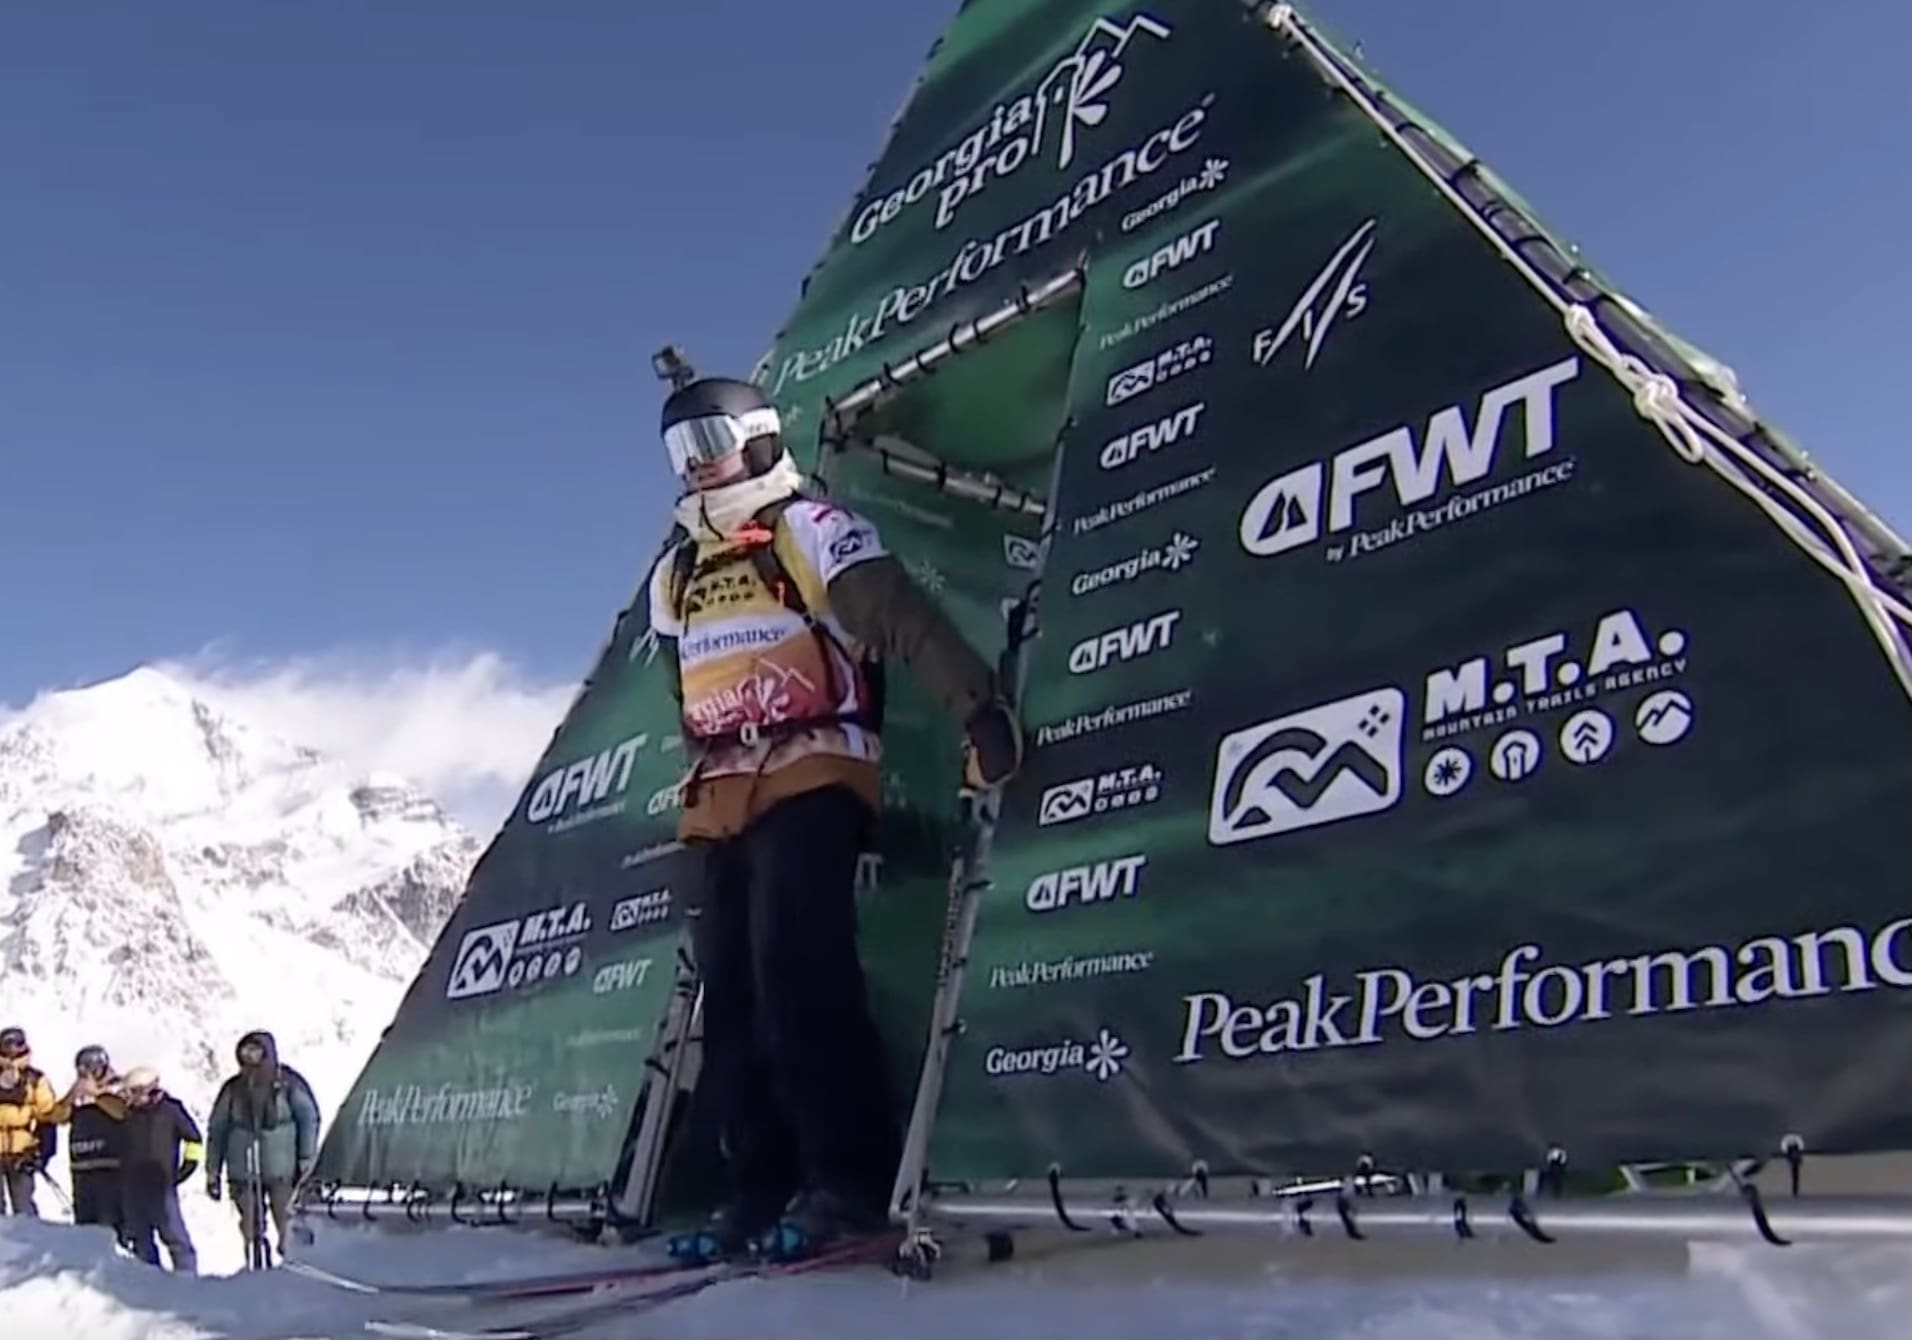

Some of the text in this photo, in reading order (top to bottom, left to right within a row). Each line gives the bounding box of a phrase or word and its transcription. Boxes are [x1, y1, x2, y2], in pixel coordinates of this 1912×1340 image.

[850, 95, 1032, 244] Georgia
[934, 135, 1027, 230] pro
[1122, 177, 1198, 231] Georgia
[772, 106, 1205, 394] PeakPerformance
[1072, 547, 1161, 596] Georgia
[1422, 658, 1687, 741] MOUNTAIN TRAILS AGENCY
[1424, 609, 1685, 724] M.T.A.
[1097, 764, 1162, 795] M.T.A.
[986, 1038, 1085, 1074] Georgia
